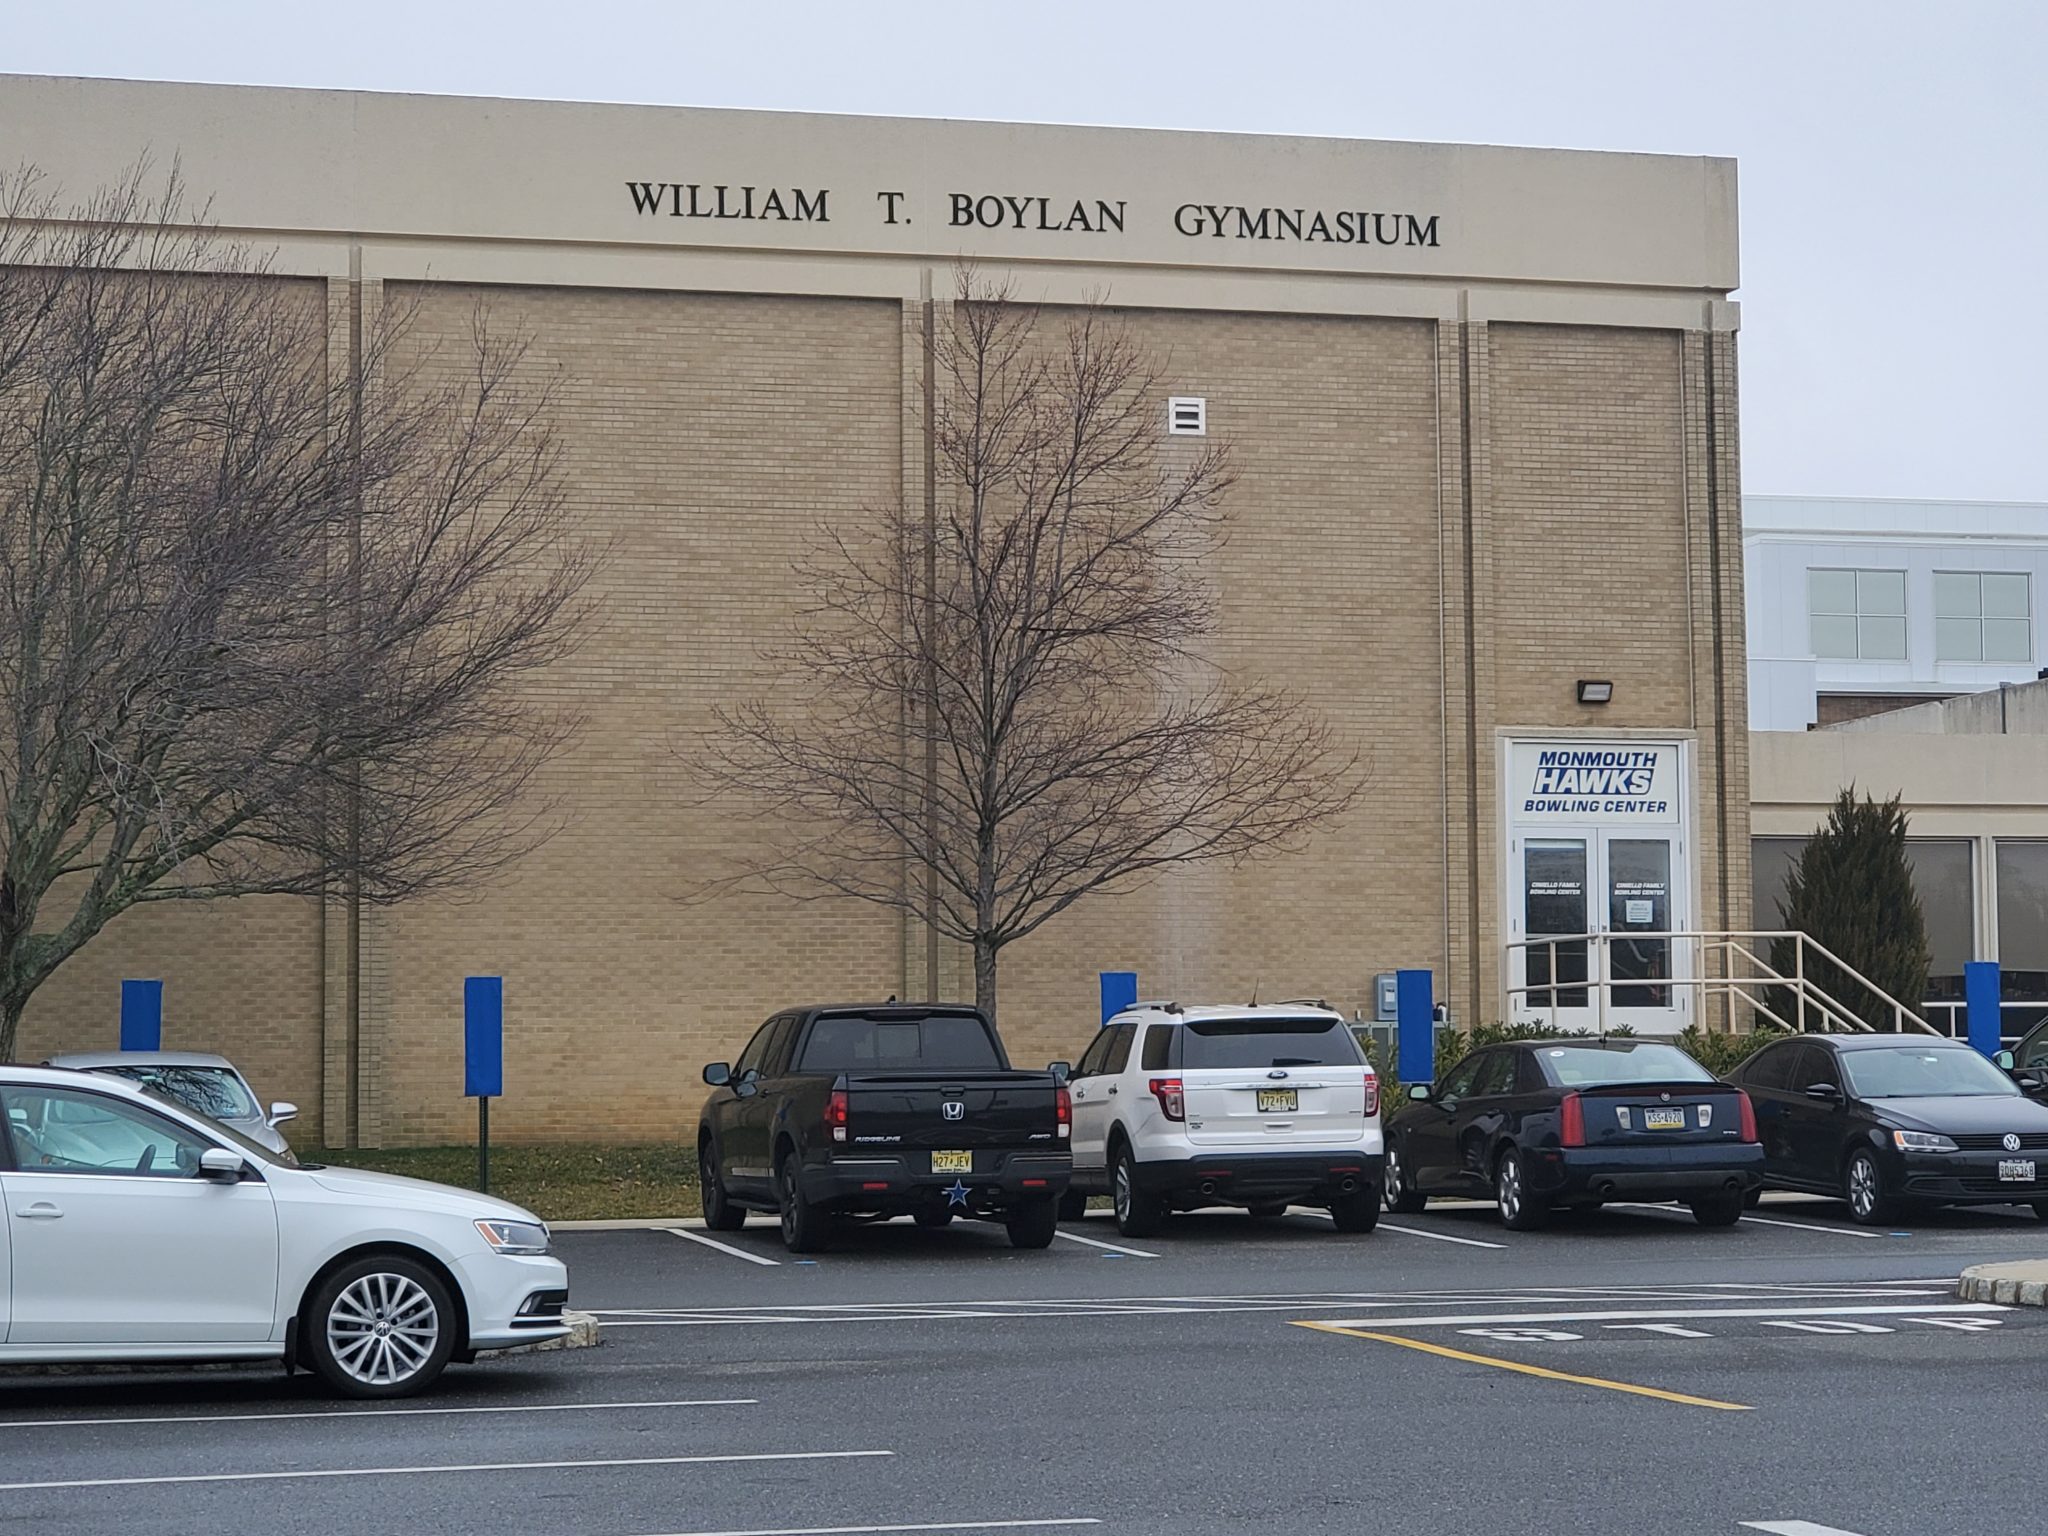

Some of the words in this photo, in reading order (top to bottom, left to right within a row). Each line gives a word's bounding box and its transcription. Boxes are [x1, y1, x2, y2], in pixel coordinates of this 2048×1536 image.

[625, 182, 830, 222] WILLIAM
[875, 191, 912, 225] T.
[948, 193, 1128, 233] BOYLAN
[1174, 204, 1441, 247] GYMNASIUM
[1539, 751, 1658, 767] MONMOUTH
[1533, 767, 1654, 795] HAWKS
[1524, 800, 1600, 812] BOWLING
[1604, 801, 1667, 813] CENTER
[1456, 1316, 2004, 1342] STOP
